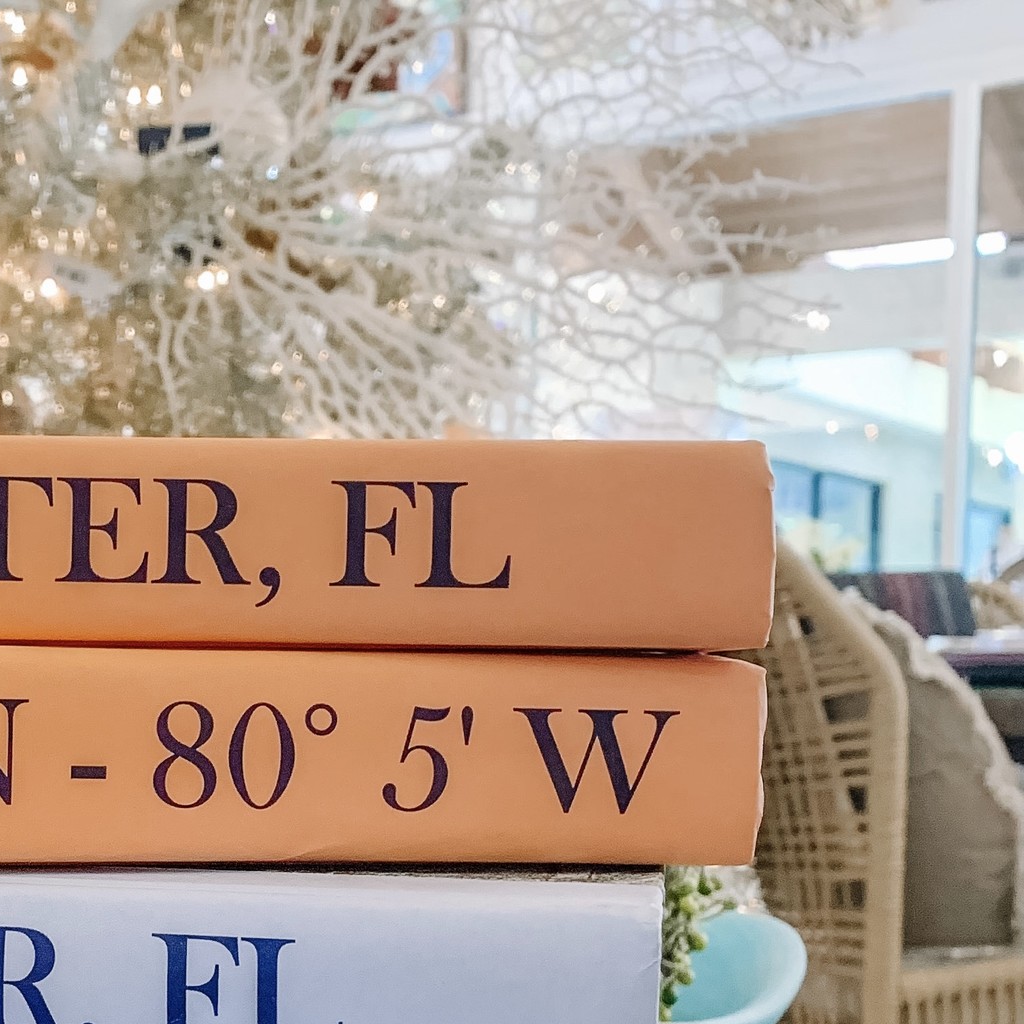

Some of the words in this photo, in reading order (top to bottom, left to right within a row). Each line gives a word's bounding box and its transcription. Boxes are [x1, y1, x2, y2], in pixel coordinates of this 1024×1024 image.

[328, 480, 512, 589] FL
[70, 765, 107, 780] -
[152, 700, 338, 810] 80°
[382, 705, 474, 813] 5'
[512, 707, 681, 815] W
